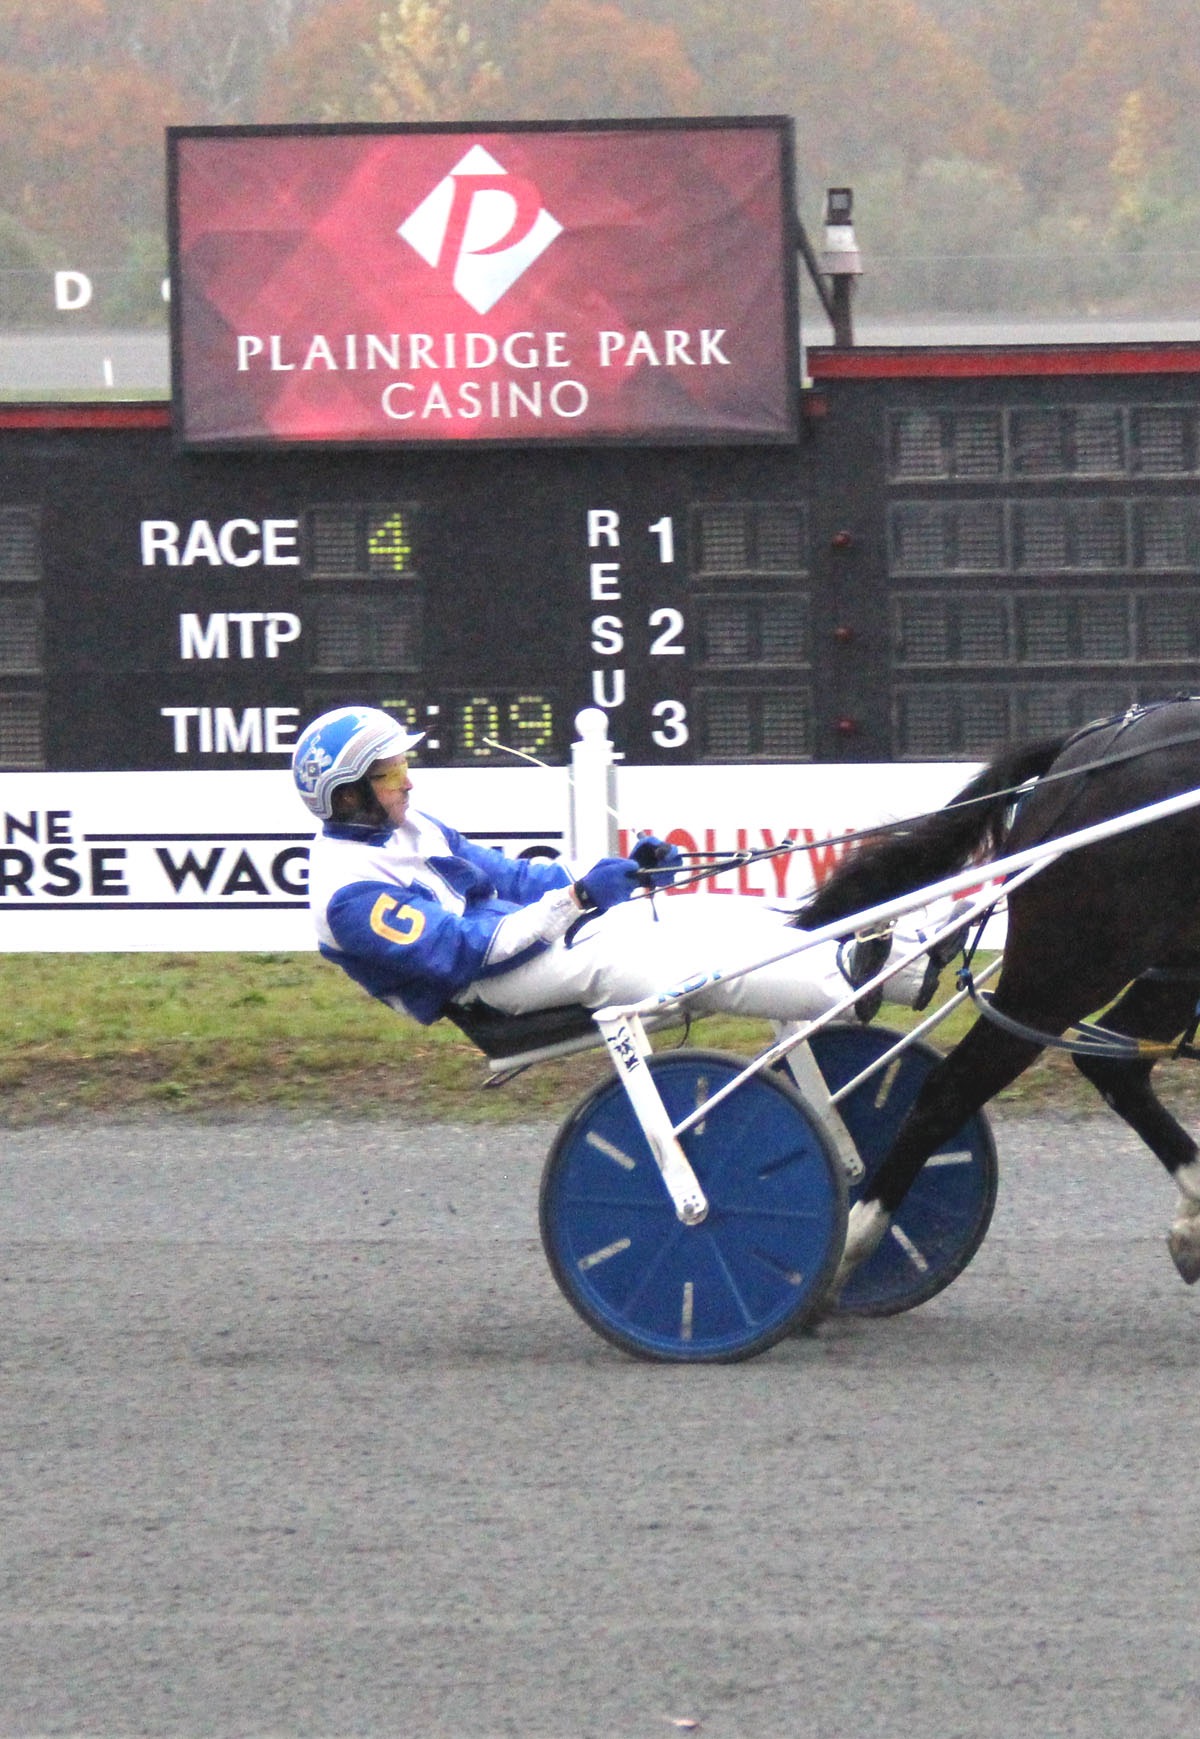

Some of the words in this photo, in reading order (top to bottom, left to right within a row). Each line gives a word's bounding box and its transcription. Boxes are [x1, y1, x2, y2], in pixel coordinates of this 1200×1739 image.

[54, 270, 93, 311] D
[236, 330, 571, 371] PLAINRIDGE
[598, 329, 731, 367] PARK
[381, 379, 589, 420] CASINO
[140, 518, 301, 567] RACE
[368, 513, 411, 571] 4
[648, 516, 674, 563] 1
[180, 612, 301, 659] MTP
[587, 509, 626, 760] RESU
[648, 608, 685, 655] 2
[160, 706, 301, 754] TIME
[651, 699, 689, 748] 3
[369, 892, 426, 945] G
